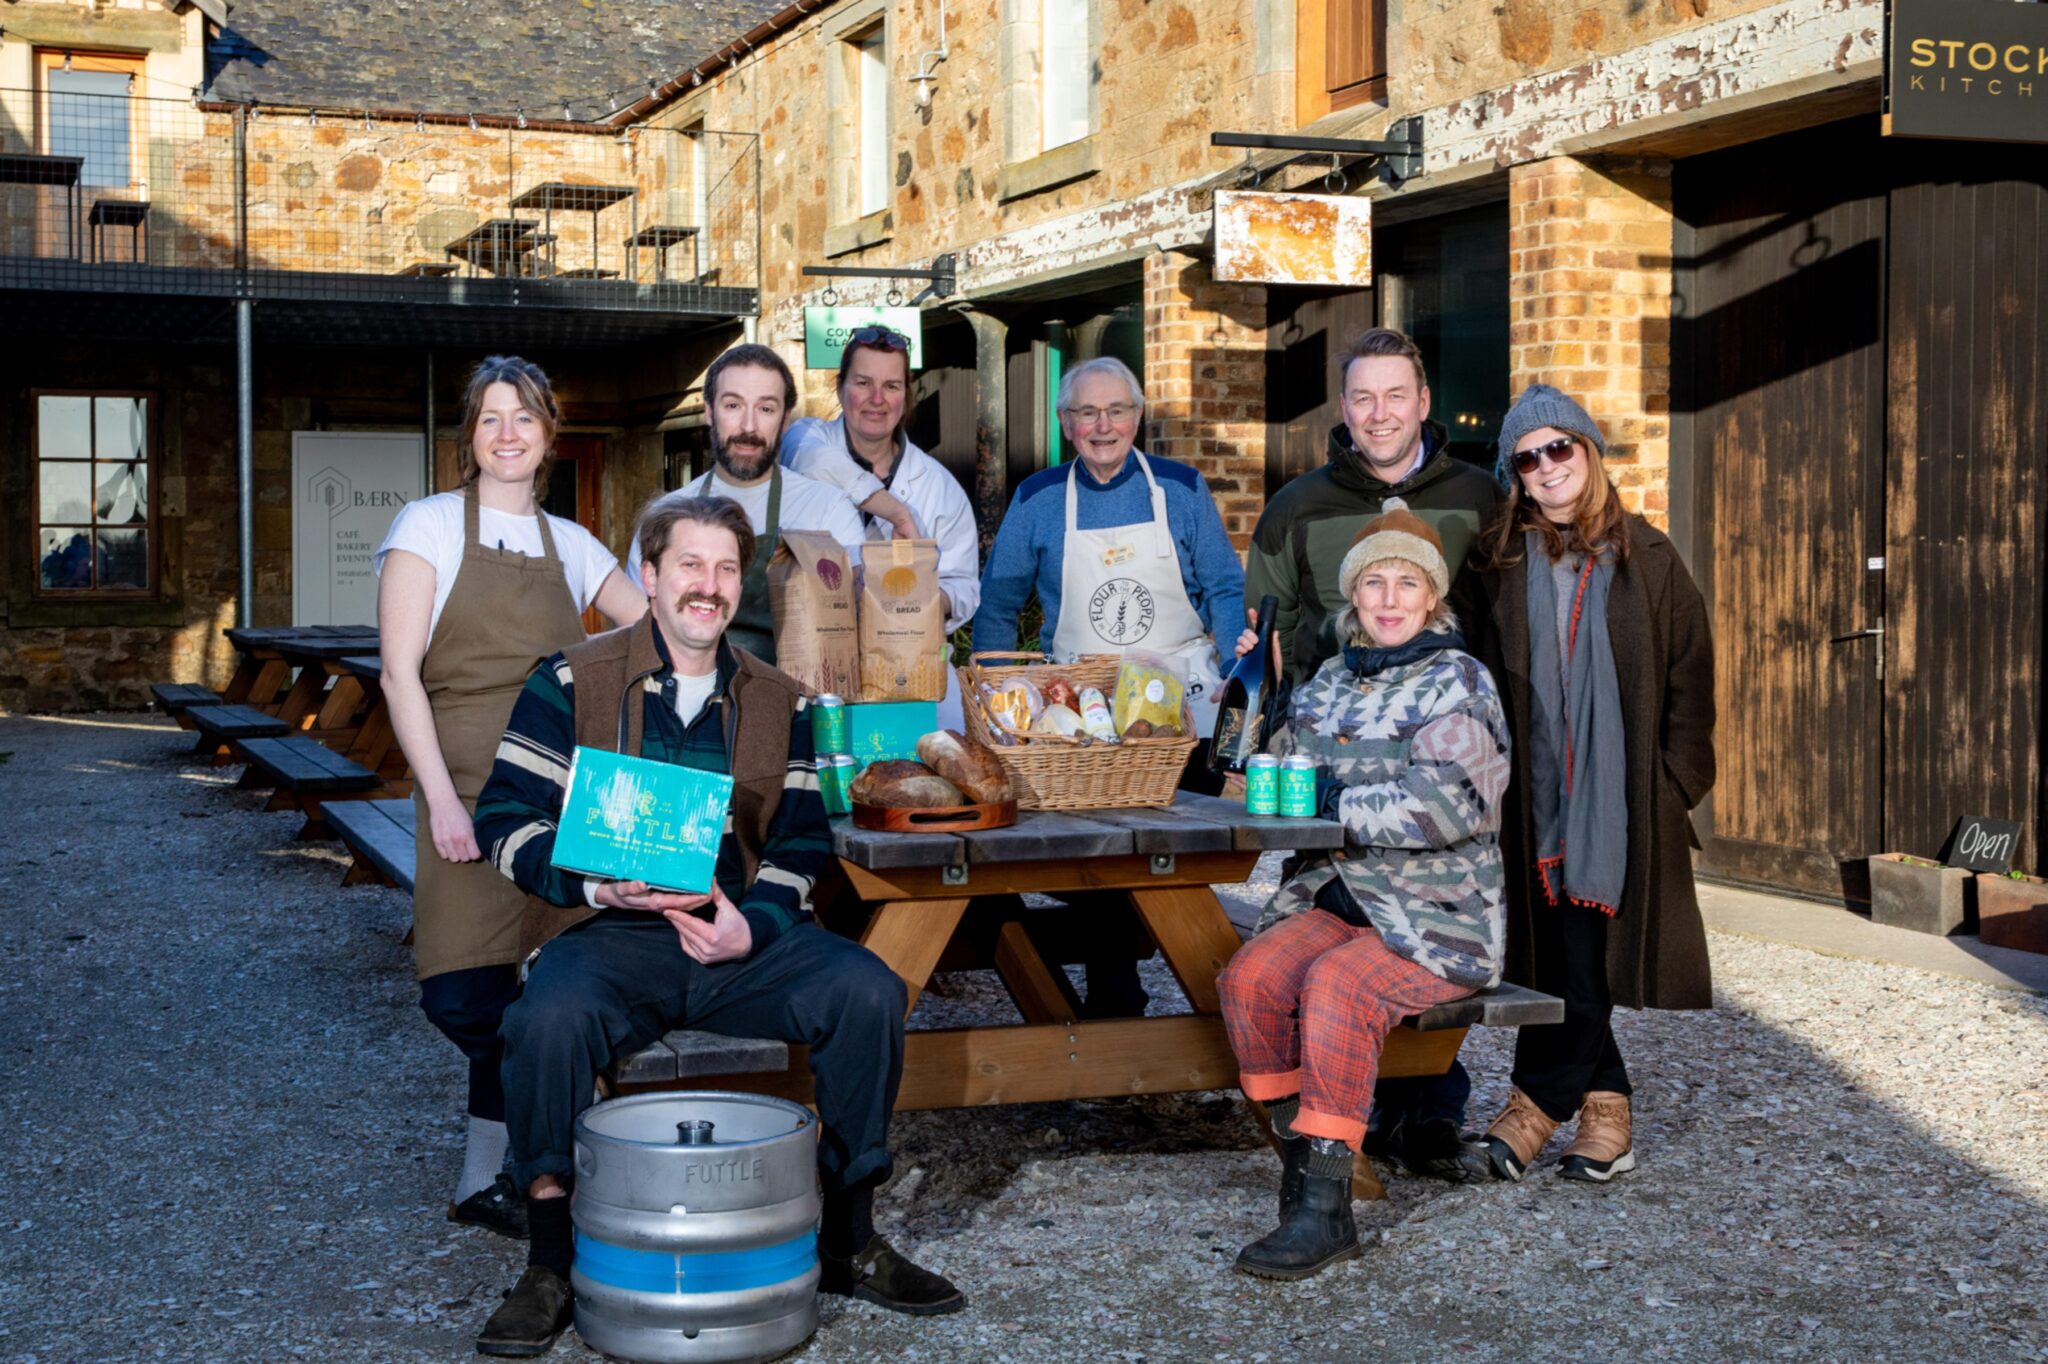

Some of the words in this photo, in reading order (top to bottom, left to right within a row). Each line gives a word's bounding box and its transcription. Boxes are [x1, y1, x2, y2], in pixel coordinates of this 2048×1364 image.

[336, 529, 360, 539] CAFÉ
[336, 543, 371, 551] BAKERY
[336, 554, 373, 563] EVENTS
[896, 606, 922, 614] BREAD
[1092, 583, 1118, 622] FLOUR
[1132, 585, 1153, 631] PEOPLE
[1960, 822, 2010, 863] Open
[686, 1159, 763, 1183] FUTTLE
